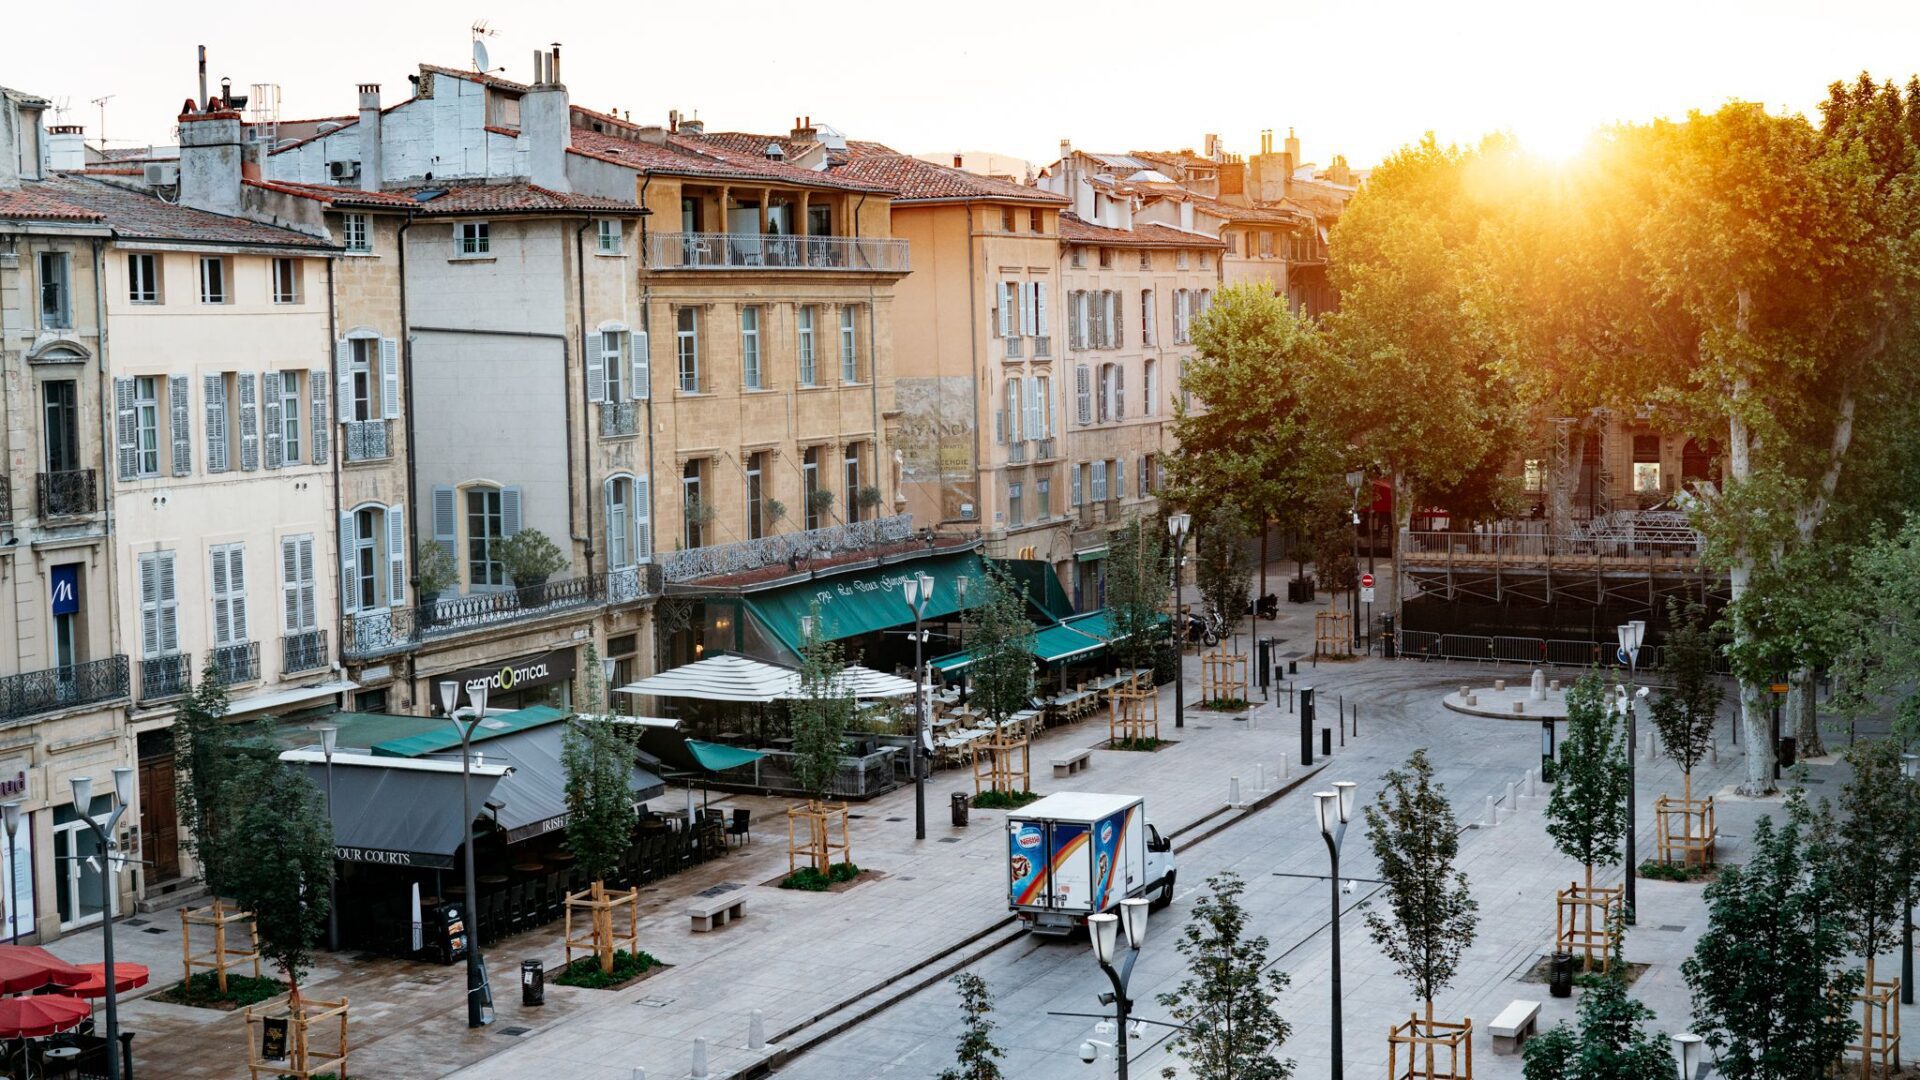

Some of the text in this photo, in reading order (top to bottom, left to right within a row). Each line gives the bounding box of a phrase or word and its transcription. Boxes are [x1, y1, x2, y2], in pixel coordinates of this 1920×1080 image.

[0, 770, 26, 797] ud
[542, 815, 563, 833] IRISH
[335, 847, 411, 865] OUR COURTS
